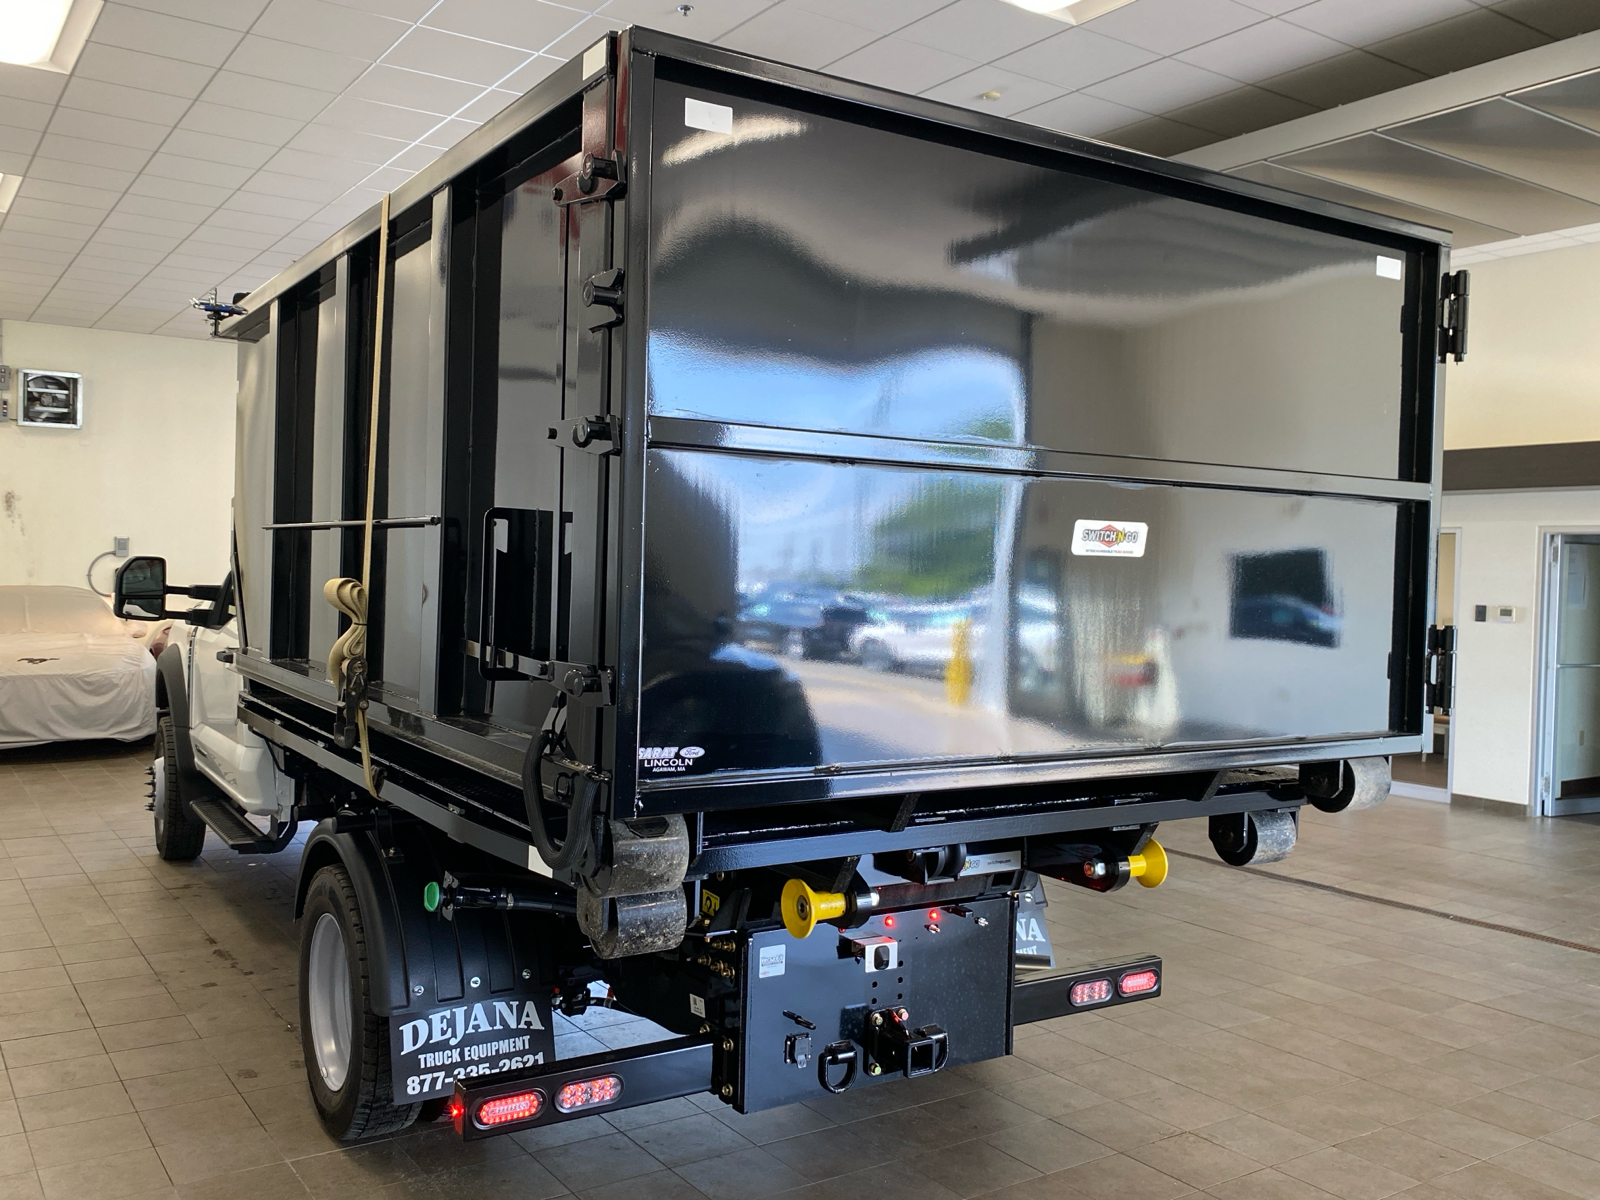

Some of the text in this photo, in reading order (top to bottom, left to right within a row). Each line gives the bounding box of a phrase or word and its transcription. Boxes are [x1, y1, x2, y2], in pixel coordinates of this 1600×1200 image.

[644, 758, 693, 767] LINCOLN
[683, 747, 701, 758] Ford
[398, 1000, 545, 1056] DEJANA
[418, 1035, 531, 1069] TRUCK EQUIPMENT
